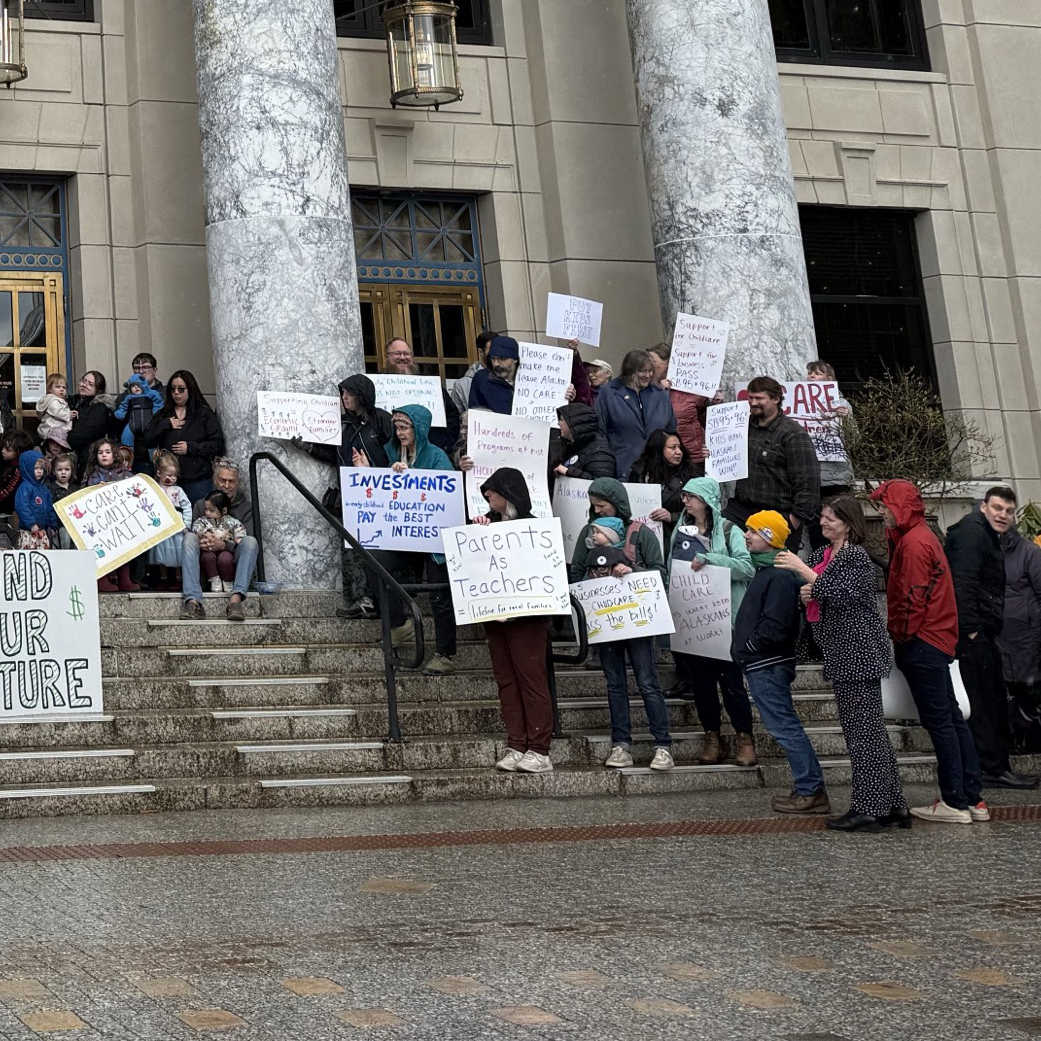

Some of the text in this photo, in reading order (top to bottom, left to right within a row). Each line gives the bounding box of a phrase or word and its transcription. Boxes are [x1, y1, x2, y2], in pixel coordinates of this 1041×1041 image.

[569, 299, 592, 314] PUT
[563, 310, 591, 325] KIDS
[679, 319, 715, 331] Support
[563, 323, 593, 339] FIRST
[521, 346, 548, 360] Please
[674, 349, 702, 359] Support
[519, 362, 560, 373] make me
[676, 368, 699, 380] PASS
[517, 388, 556, 399] NO CARE
[515, 406, 528, 415] NO
[711, 404, 739, 417] Support
[473, 420, 533, 441] Hundreds of
[477, 439, 514, 454] Programs
[709, 434, 727, 447] KIDS
[348, 472, 457, 493] INVESTMENTS
[388, 500, 446, 512] EDUCATION
[357, 510, 434, 524] PAY the BEST
[98, 509, 146, 551] WAIT
[455, 525, 553, 557] Parents
[453, 571, 555, 597] Teachers
[627, 576, 658, 591] NEED
[671, 573, 710, 589] CHILD
[682, 586, 714, 602] CARE
[66, 584, 85, 622] $
[605, 613, 624, 627] the
[679, 607, 731, 633] ALASKANS
